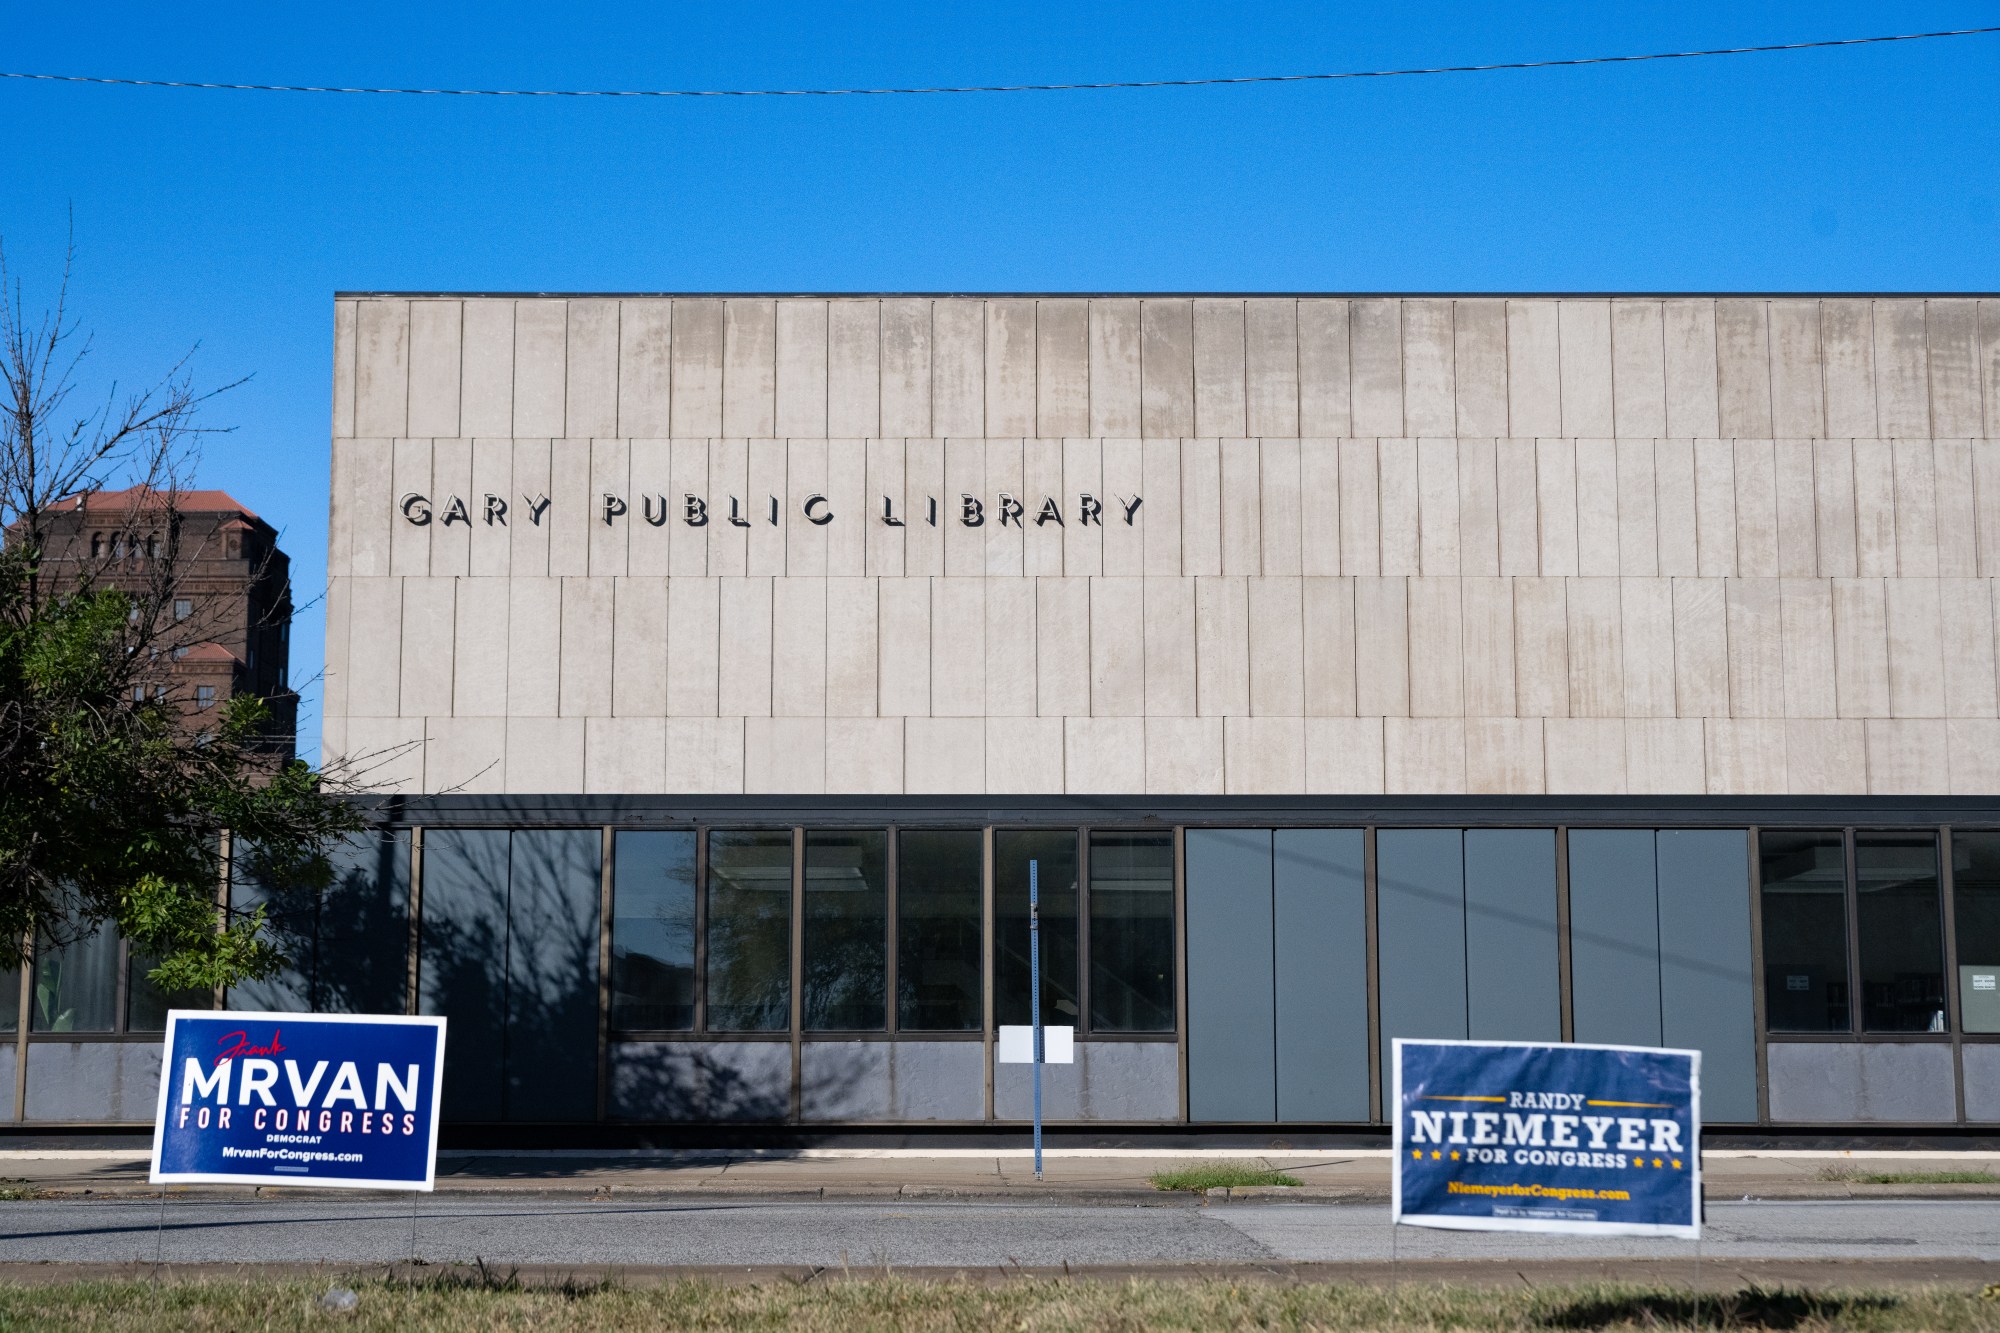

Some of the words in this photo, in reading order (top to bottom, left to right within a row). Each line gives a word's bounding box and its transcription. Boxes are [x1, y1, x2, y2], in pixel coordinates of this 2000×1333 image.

[400, 491, 551, 528] GARY
[601, 491, 835, 528] PUBLIC
[881, 491, 1143, 529] LIBRARY
[213, 1029, 287, 1067] Frank
[181, 1057, 420, 1112] MRVAN
[1509, 1091, 1586, 1110] RANDY
[179, 1107, 231, 1129] FOR
[254, 1108, 415, 1136] CONGRESS
[1410, 1110, 1684, 1152] NIEMEYER
[266, 1134, 322, 1145] DEMOCRAT
[222, 1147, 363, 1163] MrvanForCongress.com
[1466, 1149, 1508, 1164] FOR
[1513, 1150, 1627, 1169] CONGRESS
[1448, 1181, 1630, 1201] NiemeyerforCongress.com
